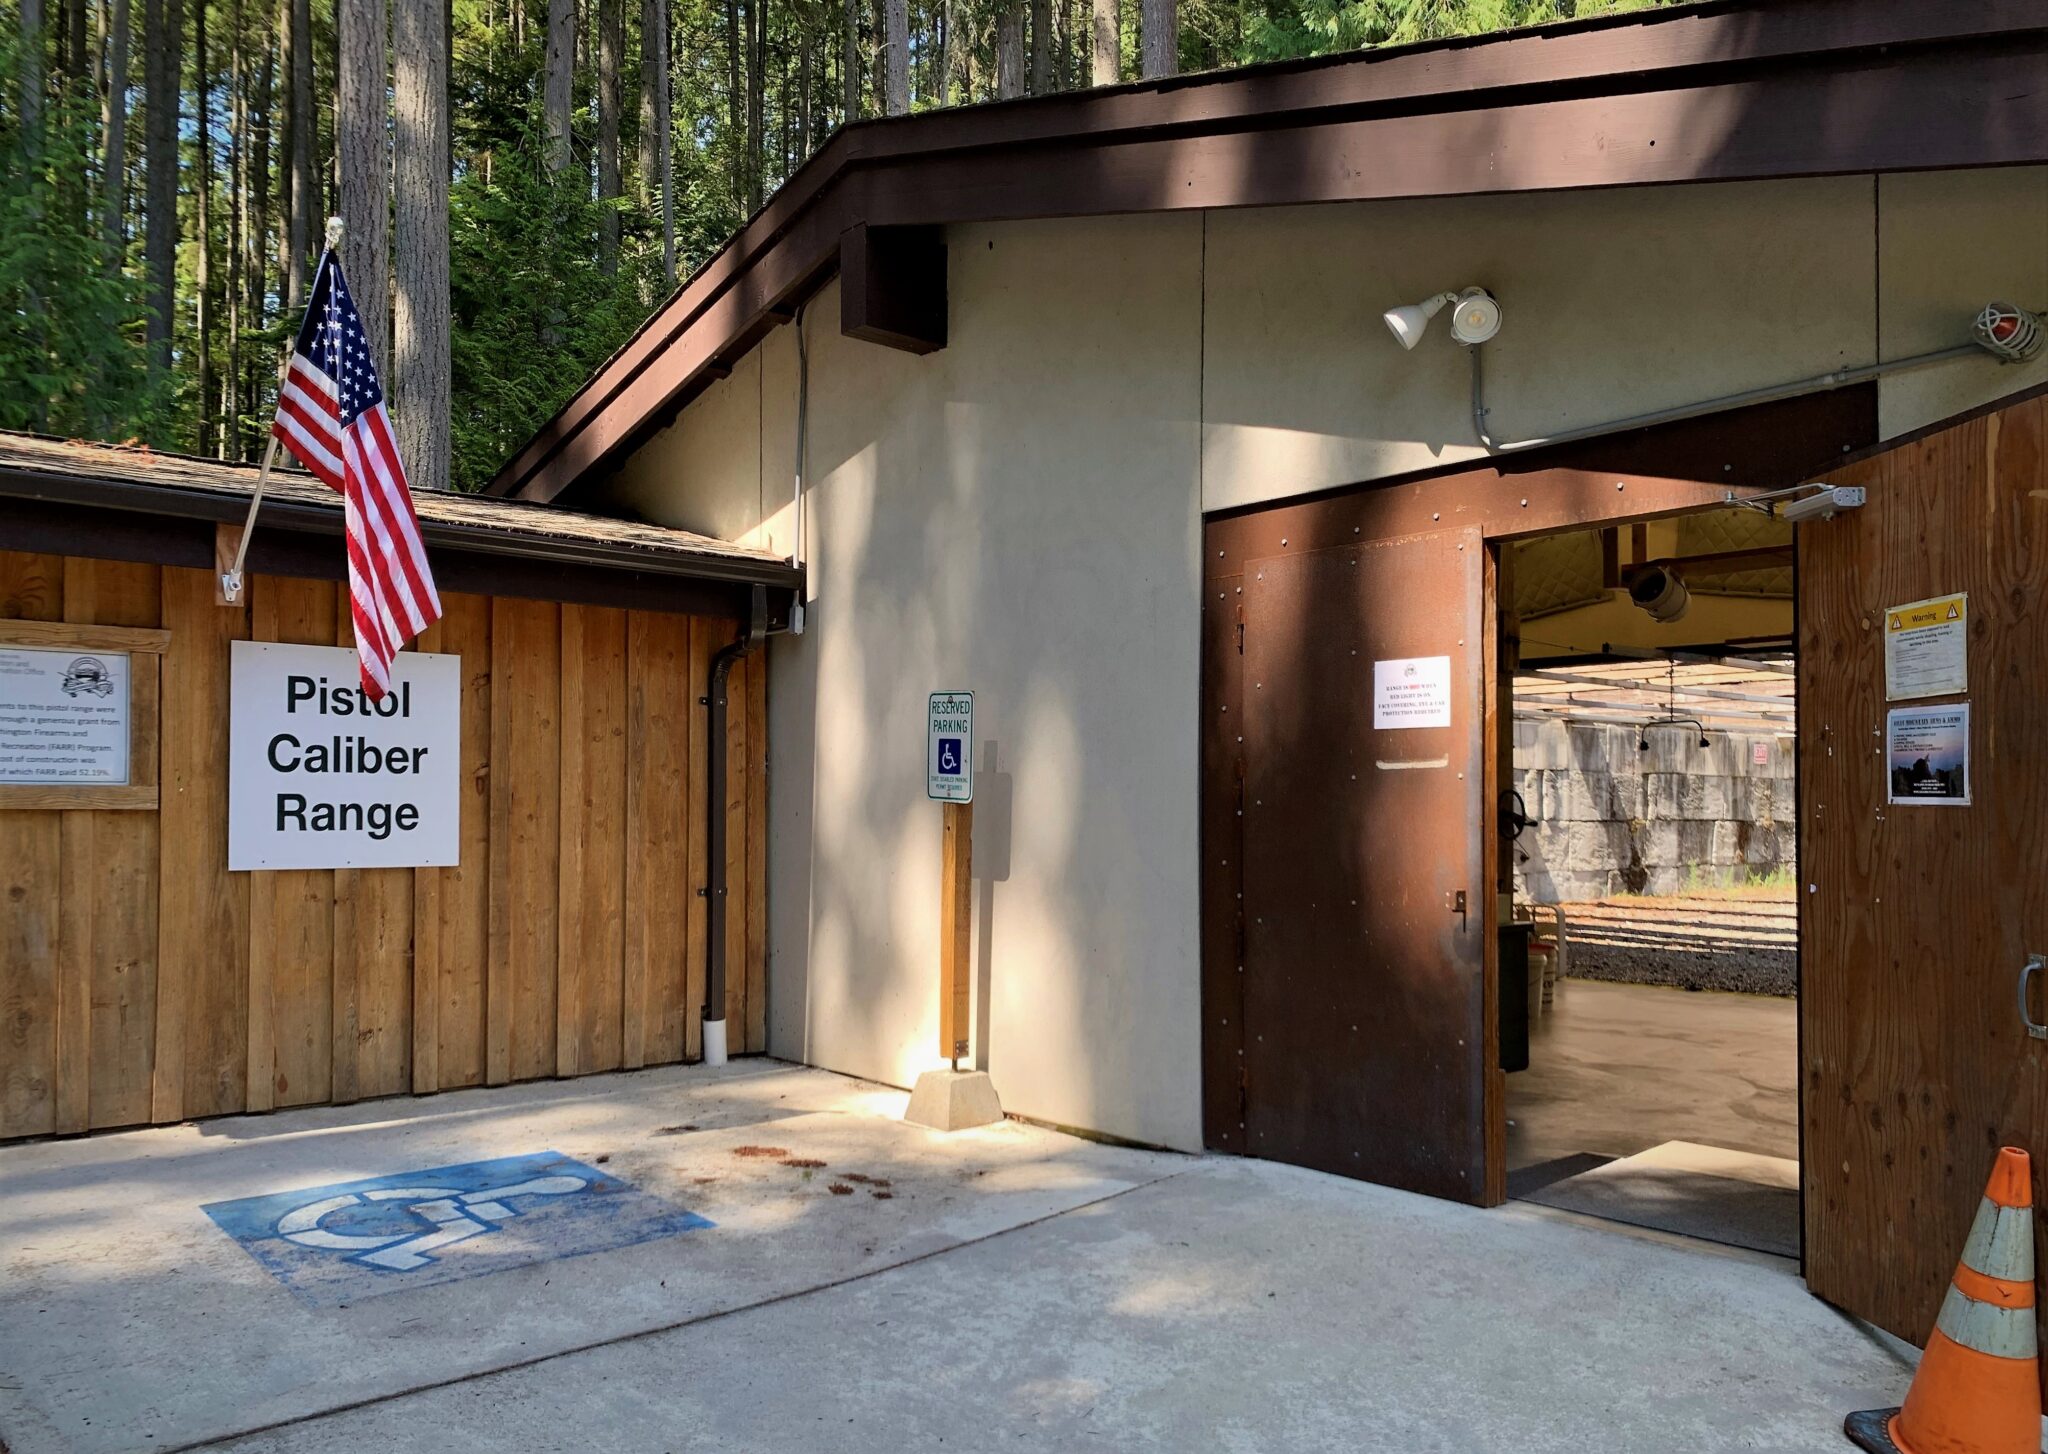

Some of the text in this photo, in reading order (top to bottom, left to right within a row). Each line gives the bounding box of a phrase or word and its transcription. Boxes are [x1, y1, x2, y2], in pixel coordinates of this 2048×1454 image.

[1911, 611, 1937, 623] Warning
[287, 675, 410, 718] Pistol
[931, 700, 971, 715] RESERVED
[37, 718, 76, 726] generous
[100, 718, 121, 726] from
[933, 719, 968, 733] PARKING
[34, 729, 71, 737] Firearms
[267, 733, 429, 774] Caliber
[8, 768, 34, 776] which
[58, 769, 78, 777] paid
[276, 793, 420, 840] Range
